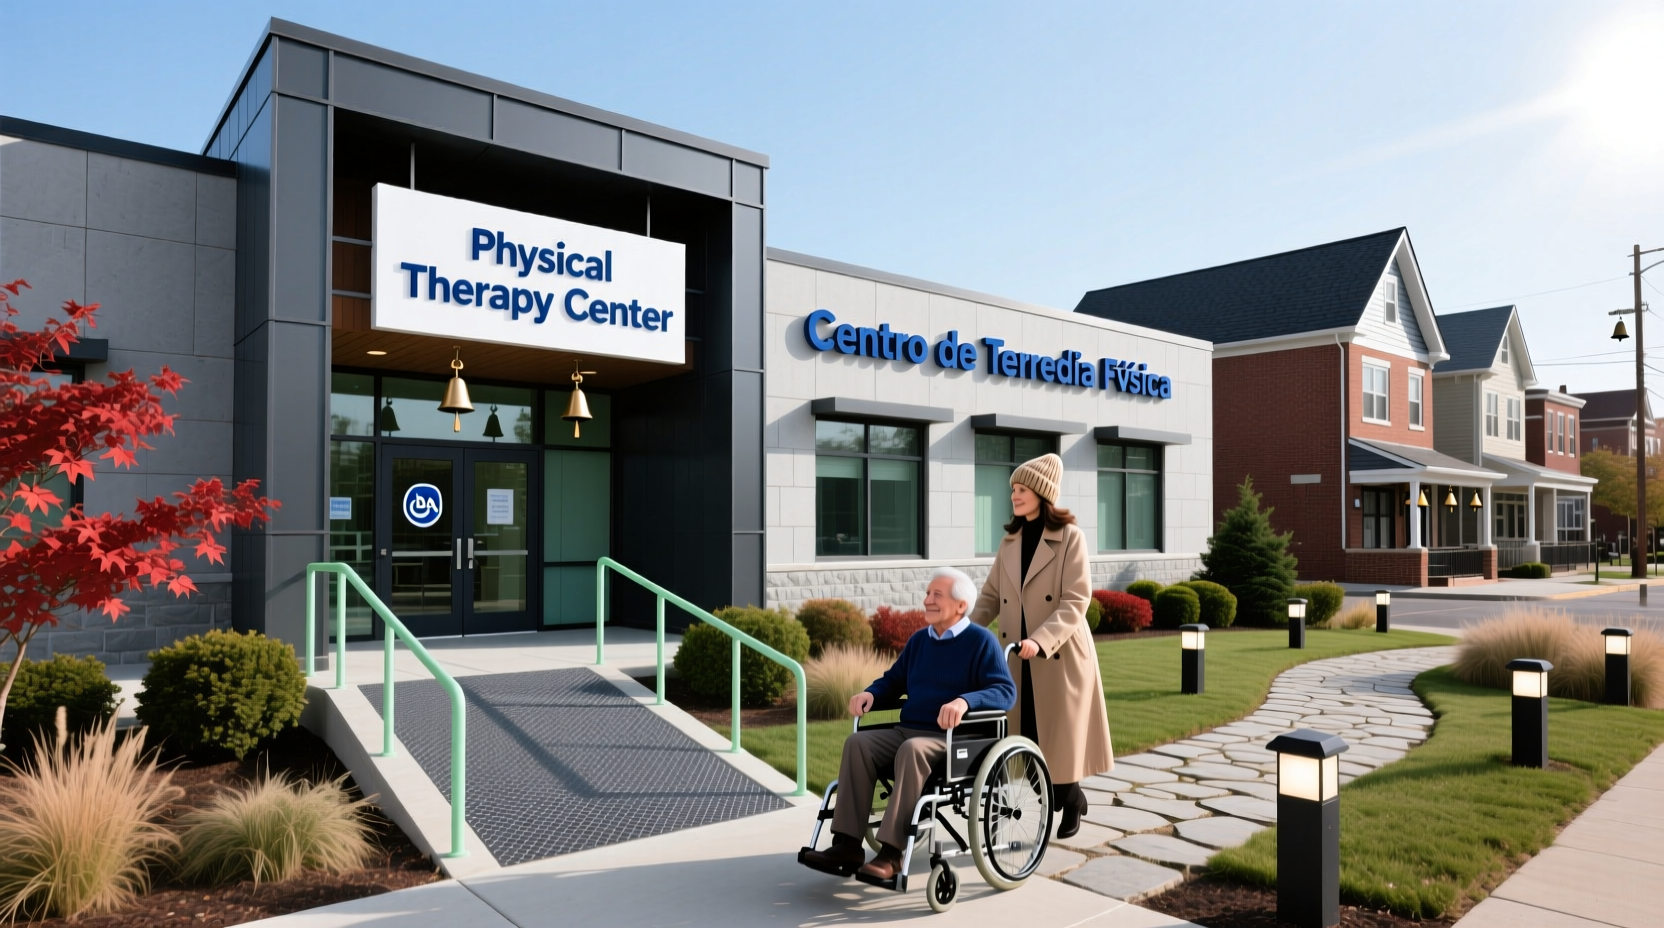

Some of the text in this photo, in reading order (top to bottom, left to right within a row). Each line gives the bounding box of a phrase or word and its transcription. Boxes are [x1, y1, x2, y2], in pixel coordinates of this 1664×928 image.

[471, 227, 613, 283] Physical
[400, 261, 674, 333] Therapy Center
[803, 308, 929, 365] Centro
[935, 330, 978, 371] de
